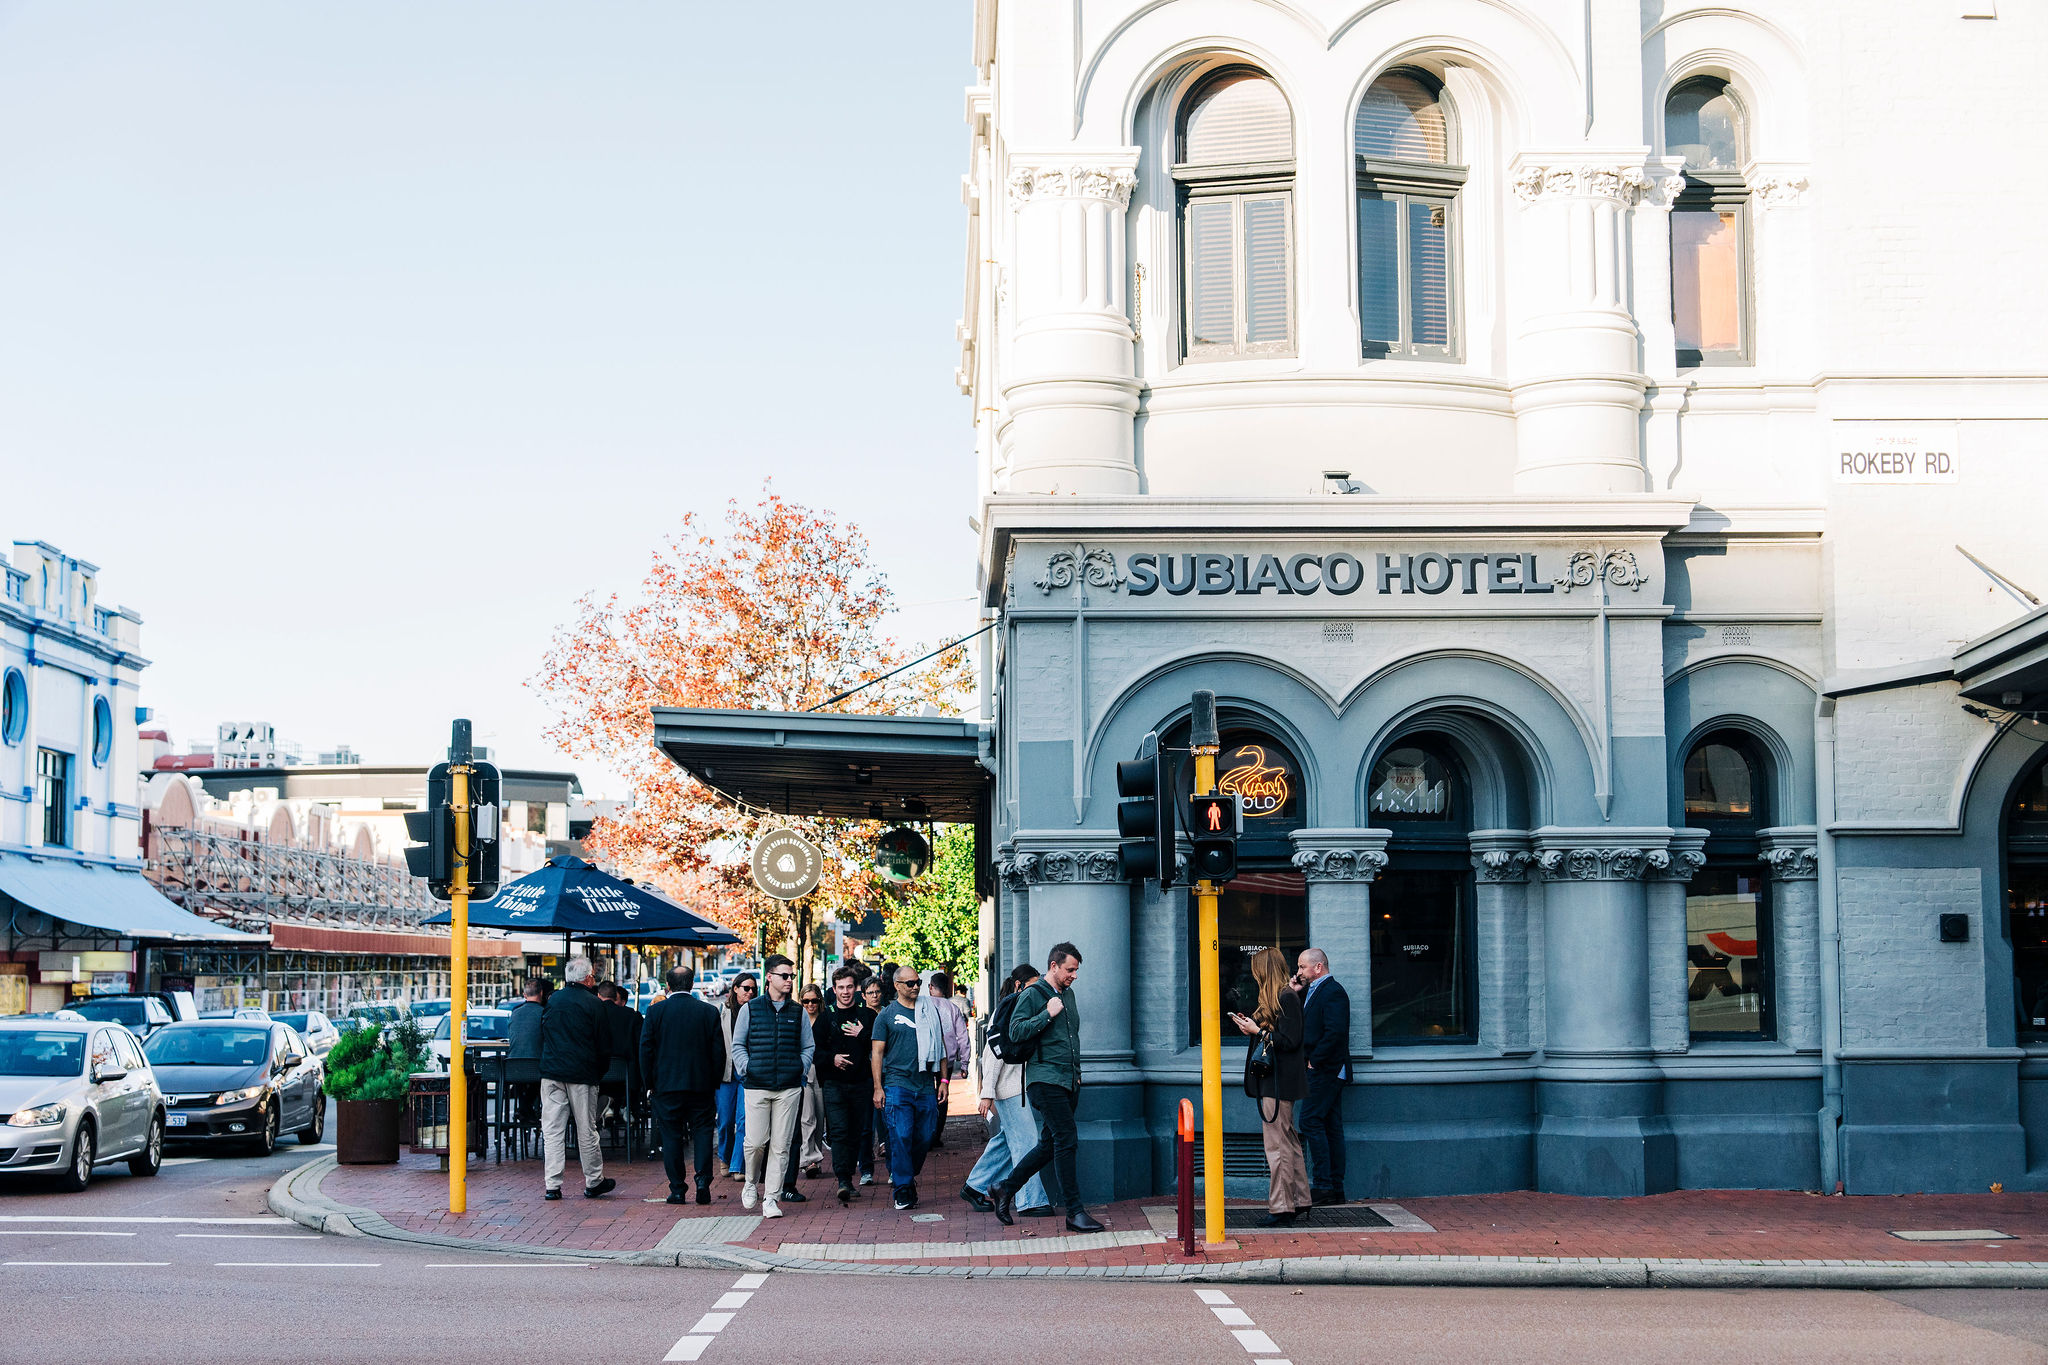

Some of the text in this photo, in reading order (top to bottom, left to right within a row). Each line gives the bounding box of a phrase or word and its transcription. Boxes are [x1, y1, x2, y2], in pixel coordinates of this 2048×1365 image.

[1841, 452, 1954, 474] ROKEBY RD.
[1126, 552, 1554, 595] SUBIACO HOTEL
[1224, 781, 1280, 796] SWAN
[1241, 796, 1275, 809] OLD
[510, 883, 546, 899] Little
[576, 885, 624, 898] Little
[494, 895, 539, 919] Things
[581, 898, 641, 920] Things
